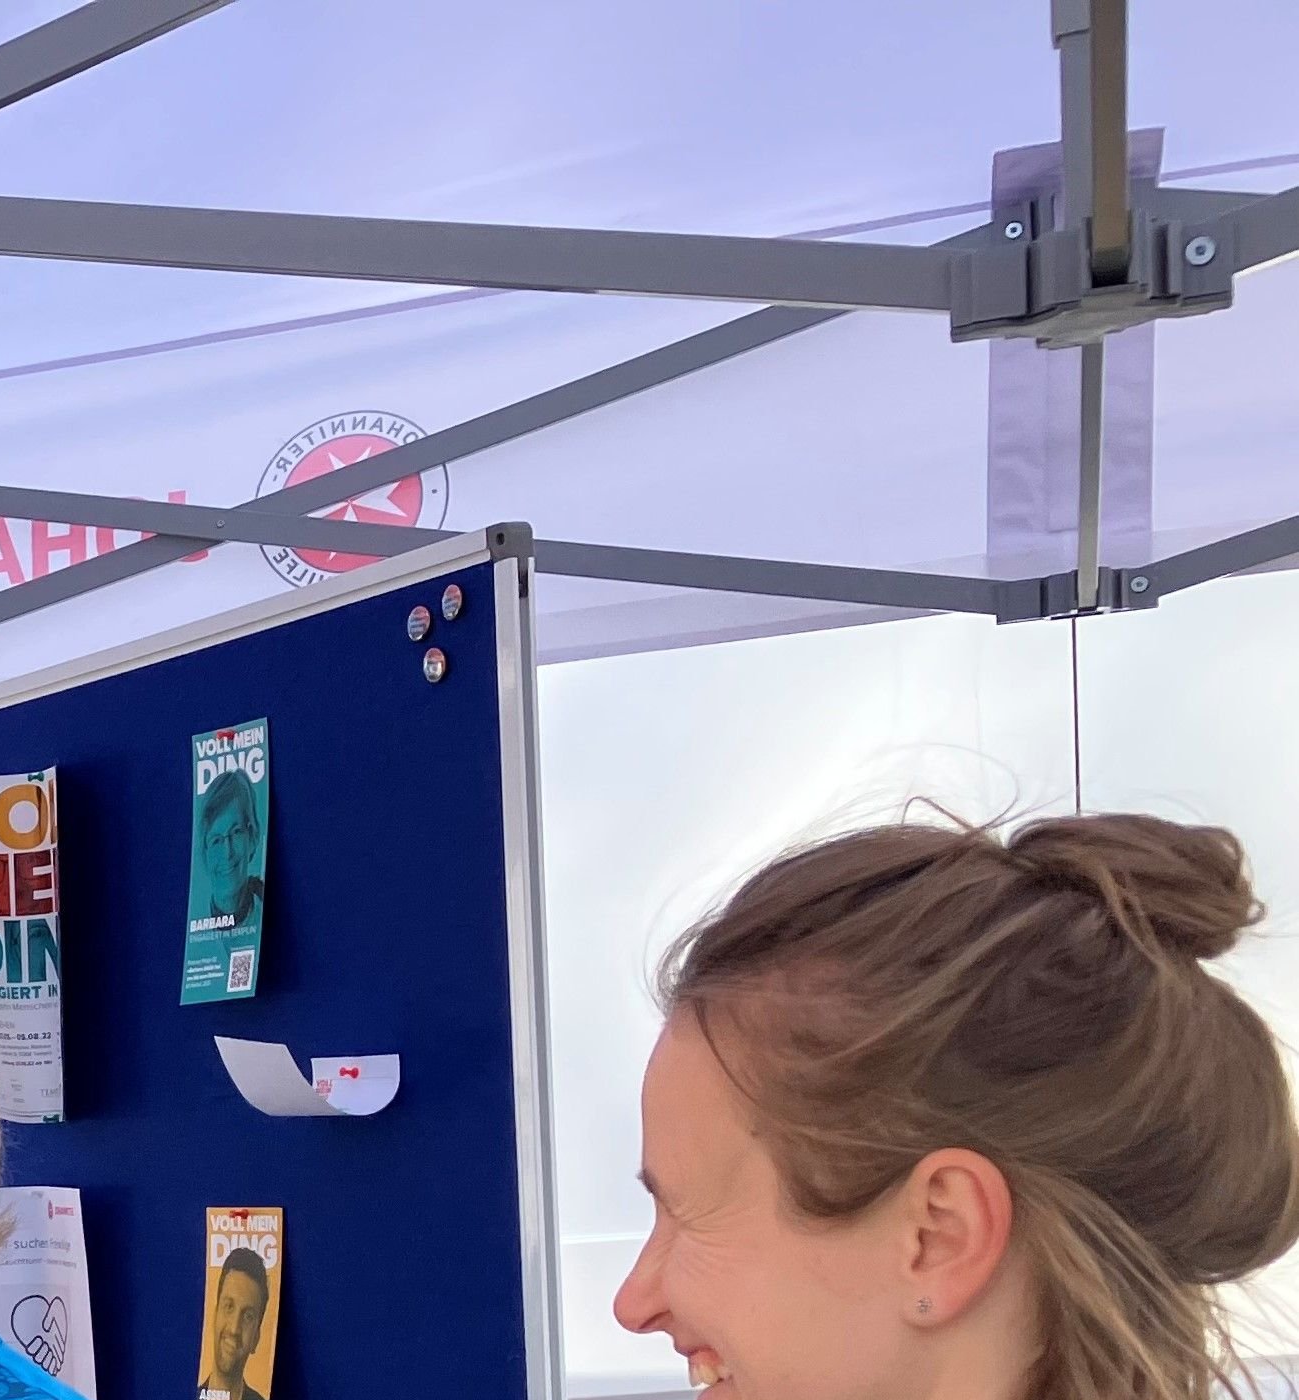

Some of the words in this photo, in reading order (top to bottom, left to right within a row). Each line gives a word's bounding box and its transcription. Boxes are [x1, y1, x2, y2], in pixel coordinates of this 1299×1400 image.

[196, 736, 231, 758] VOLL
[233, 726, 264, 750] MEIN
[197, 747, 265, 795] DING
[210, 1214, 244, 1231] VOLL
[246, 1214, 278, 1232] MEIN
[210, 1234, 278, 1270] DING
